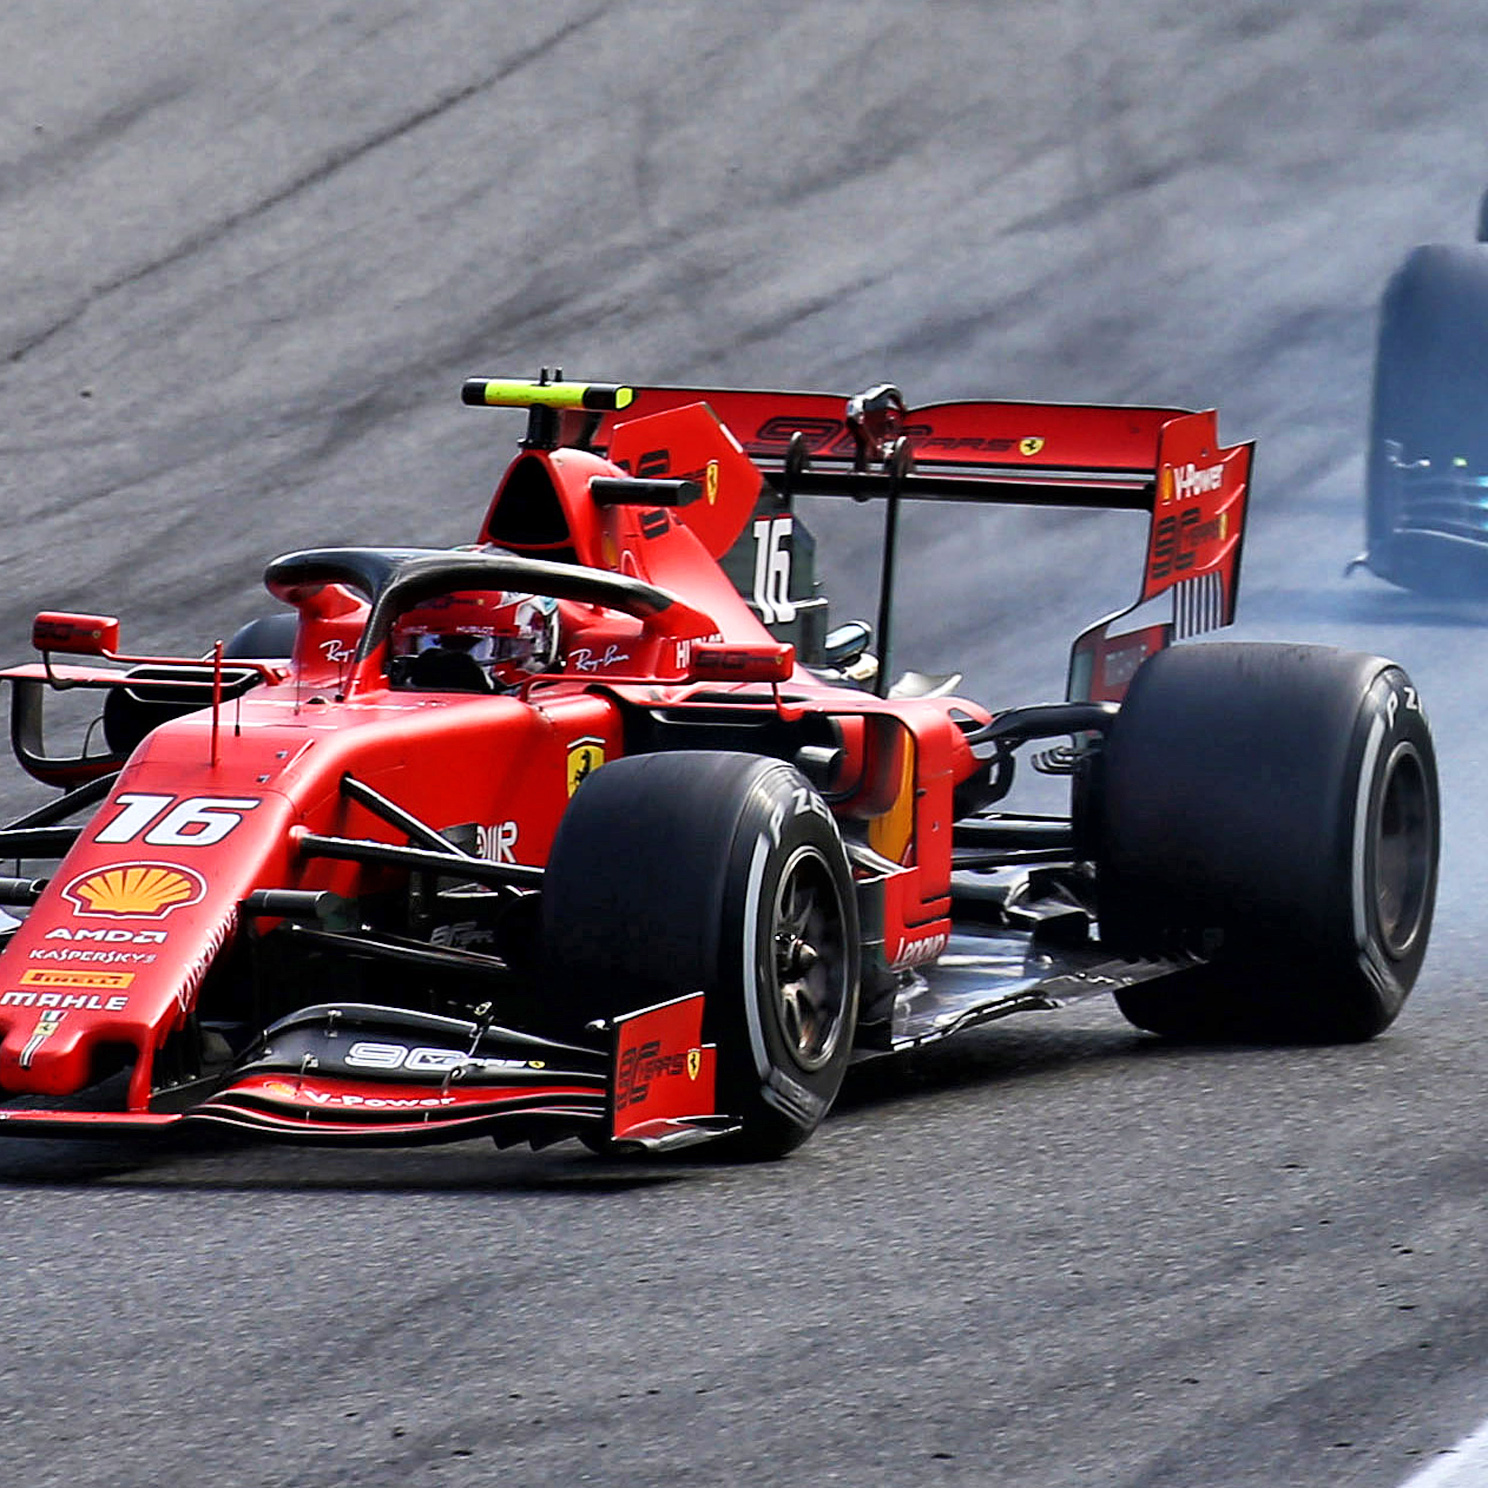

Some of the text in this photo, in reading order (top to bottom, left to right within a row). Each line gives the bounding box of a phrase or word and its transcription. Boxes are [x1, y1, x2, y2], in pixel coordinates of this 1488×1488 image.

[753, 516, 797, 625] 16
[568, 644, 630, 671] Ray-Ban
[94, 792, 261, 847] 16
[29, 949, 145, 963] KASPERSKY
[0, 992, 129, 1011] MAHLE
[344, 1042, 470, 1072] 90
[303, 1090, 456, 1109] V-Power
